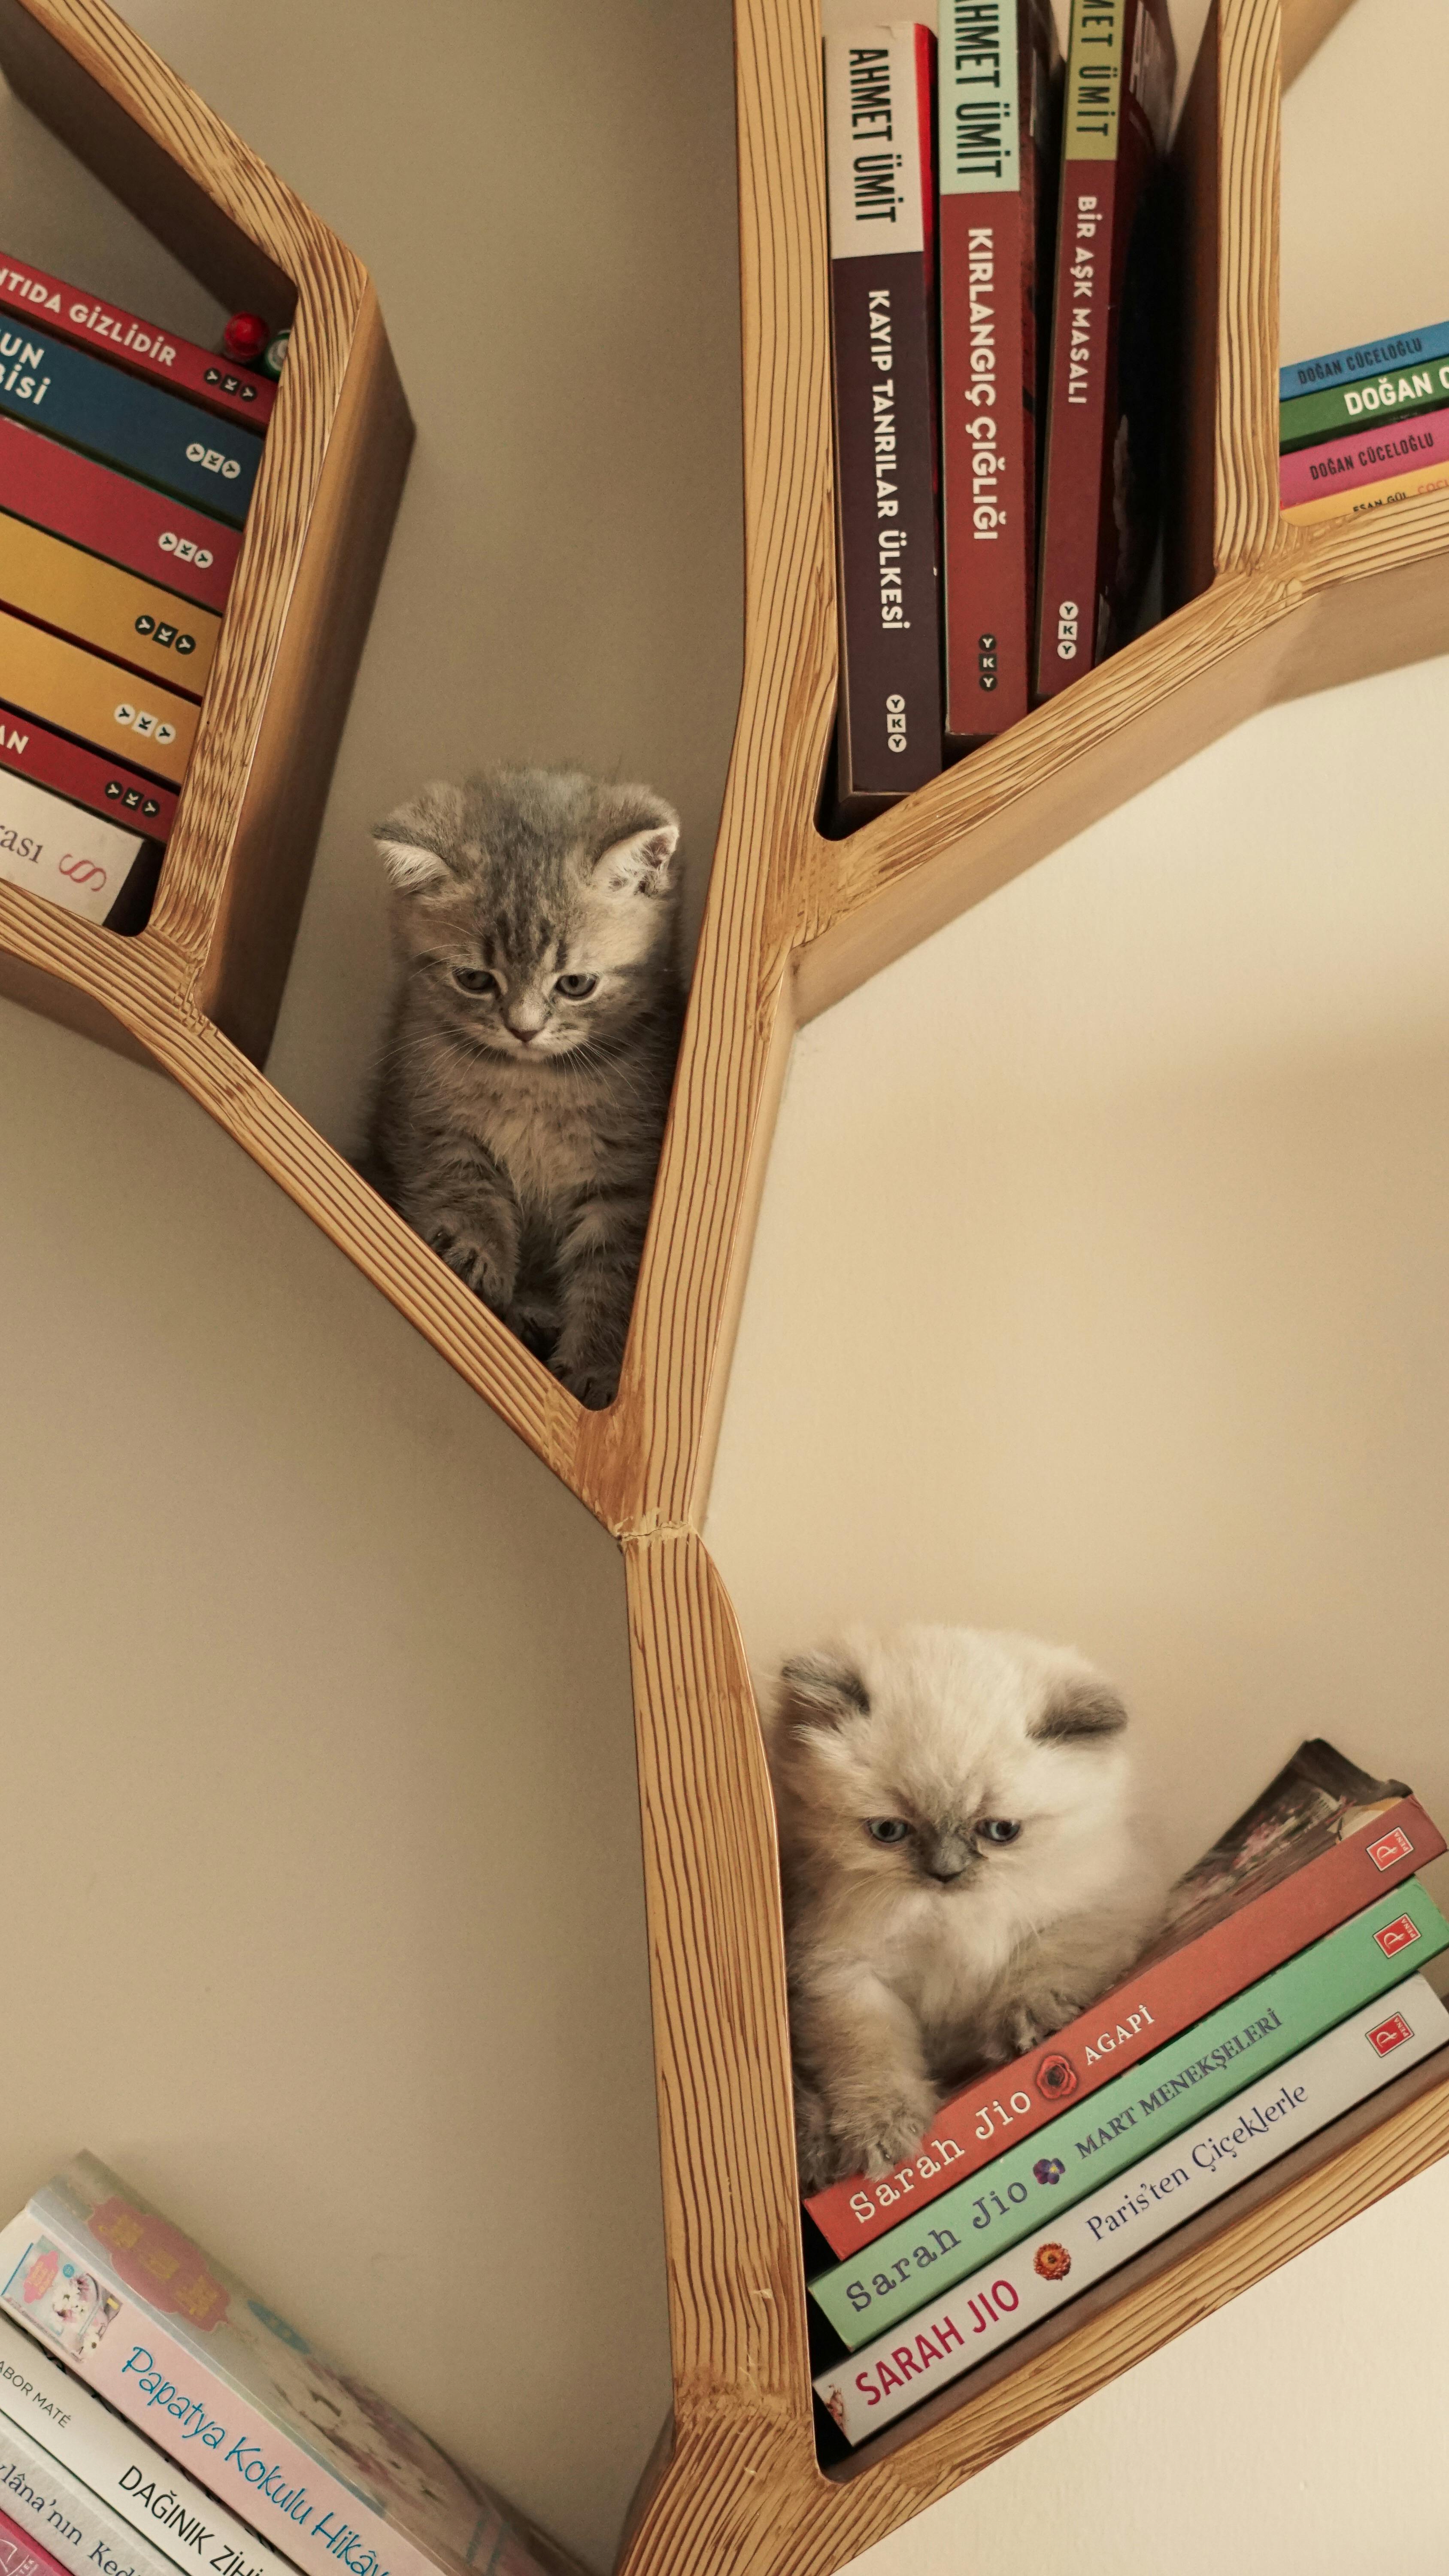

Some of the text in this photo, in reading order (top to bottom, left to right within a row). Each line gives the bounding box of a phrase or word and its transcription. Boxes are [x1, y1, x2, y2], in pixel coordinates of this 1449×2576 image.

[954, 0, 1011, 177] HMET ÜMİT
[1076, 65, 1117, 136] ÜMİT
[849, 49, 904, 223] AHMET ÜMİT
[69, 304, 176, 366] GİZLİDİR
[1068, 195, 1102, 404] BİR AŞK MASALI
[0, 332, 44, 370] UN
[965, 228, 1006, 540] KIRLANGIÇ ÇIĞLIĞI
[1297, 337, 1422, 384] DOĞAN CÜCELOĞLU
[1344, 371, 1433, 415] DOĞAN
[869, 290, 910, 629] KAYIP TANRILAR ÜLKESİ
[1310, 432, 1434, 480] DOĞAN CÜCELOĞLU
[0, 825, 42, 863] ası
[849, 2004, 1155, 2223] Sarah Jio AGAPİ
[846, 2008, 1283, 2312] Sarah Jio MART MENEKŞELERİ
[855, 2084, 1308, 2405] SARAH JIO Paris'ten Çiçeklerle
[32, 2392, 72, 2428] MATÉ
[122, 2346, 226, 2449] Papatya
[224, 2436, 313, 2524] Kokulu
[87, 2540, 140, 2576] Ke
[118, 2465, 263, 2576] DAĞINIK ZİH
[16, 2558, 35, 2576] TEK
